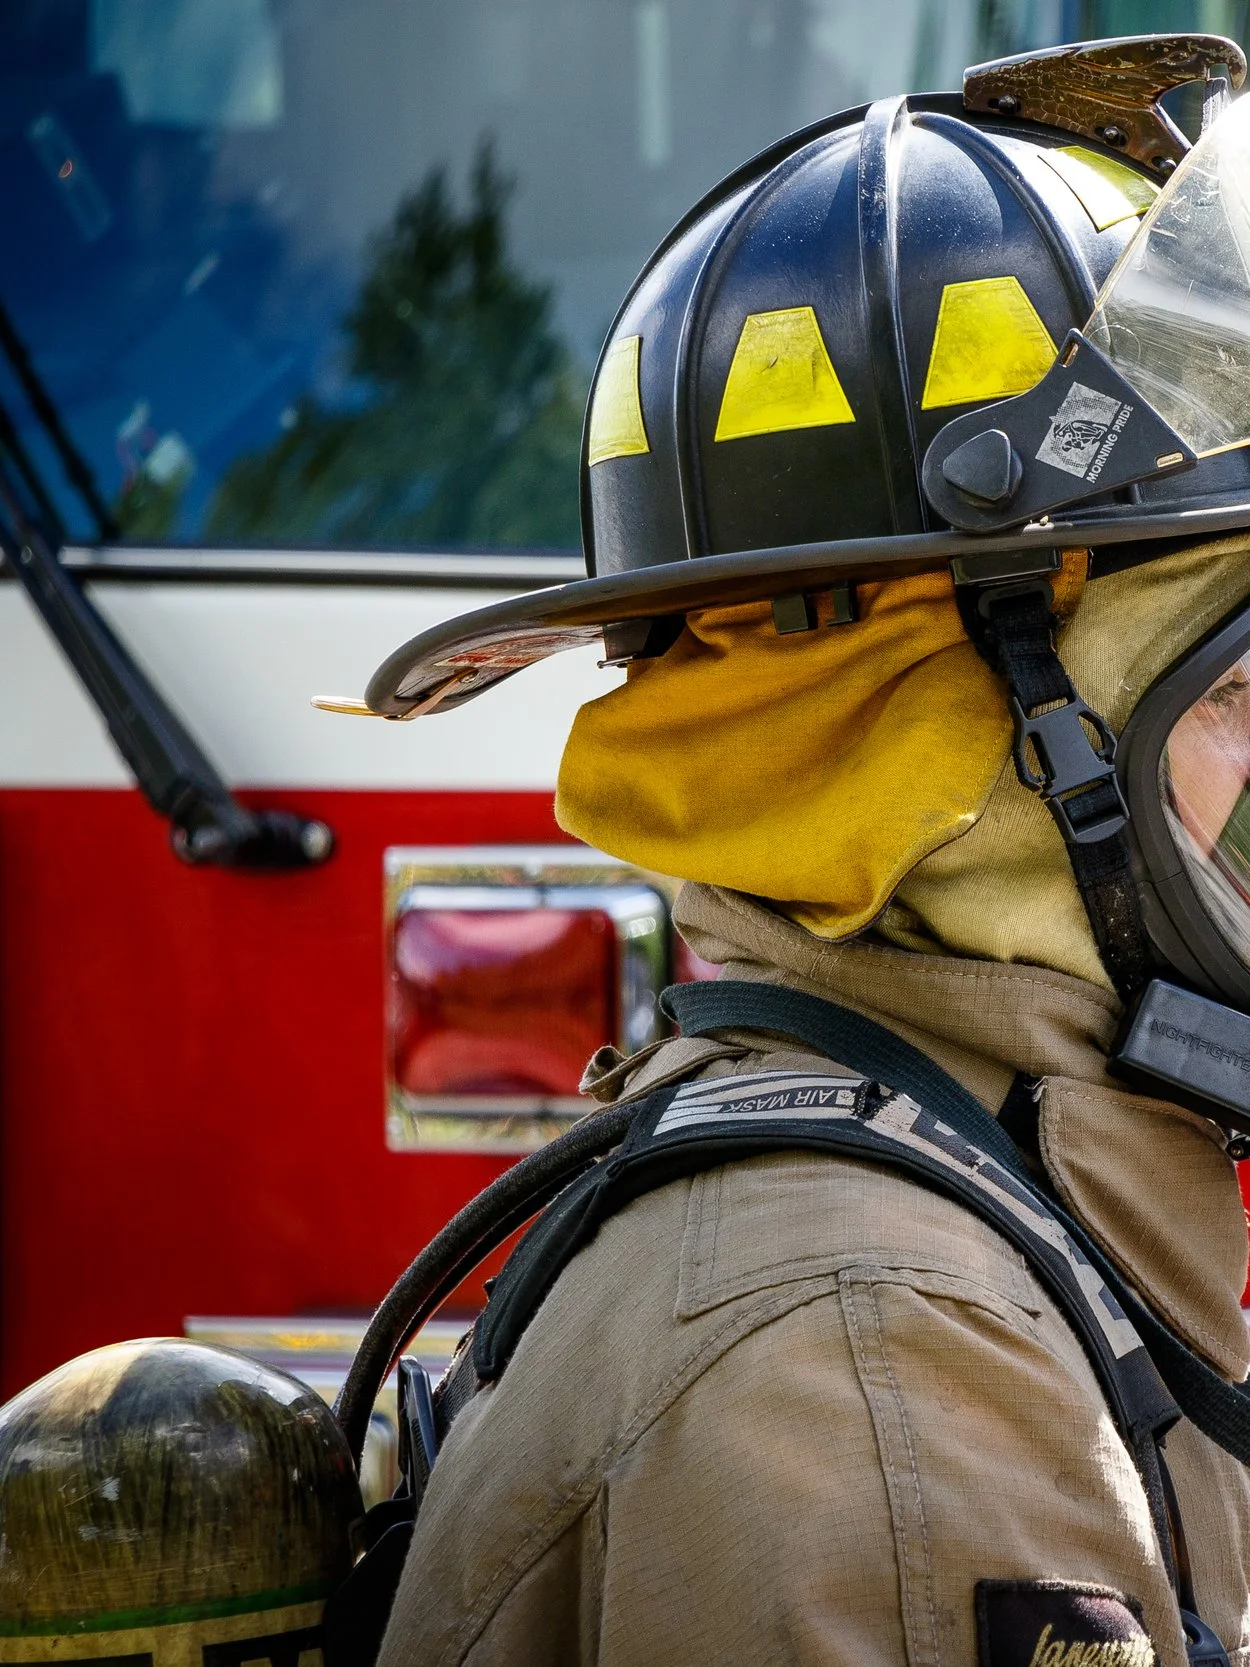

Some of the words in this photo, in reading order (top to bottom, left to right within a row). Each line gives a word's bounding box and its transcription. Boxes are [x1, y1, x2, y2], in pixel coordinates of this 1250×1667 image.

[1086, 433, 1118, 483] MORNING
[1112, 404, 1134, 433] PRIDE
[722, 1093, 791, 1113] MASK
[794, 1089, 836, 1106] AIR
